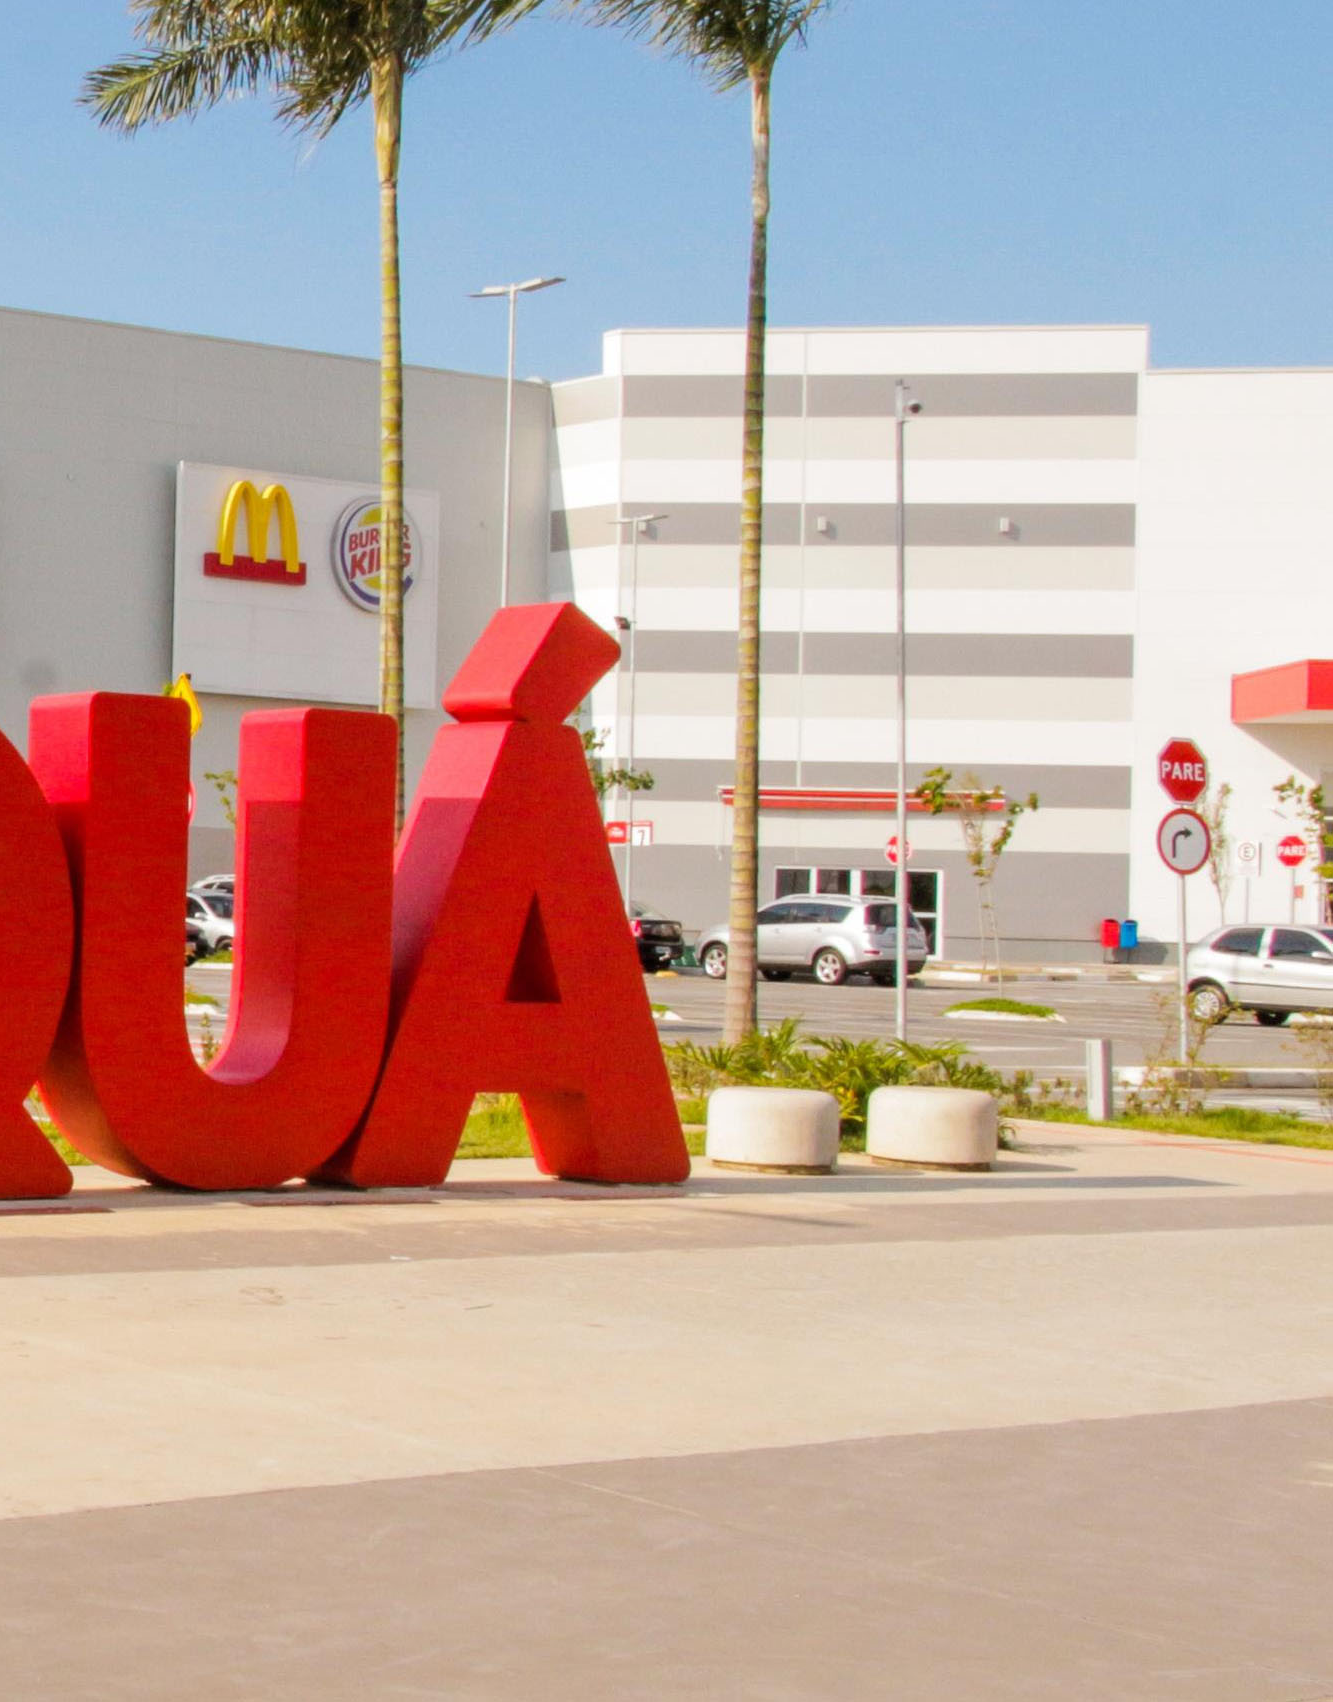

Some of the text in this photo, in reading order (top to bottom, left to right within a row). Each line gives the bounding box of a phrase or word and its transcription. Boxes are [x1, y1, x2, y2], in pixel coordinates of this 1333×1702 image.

[349, 525, 411, 553] BURR
[1161, 761, 1204, 782] PARE
[1277, 844, 1308, 857] PARE
